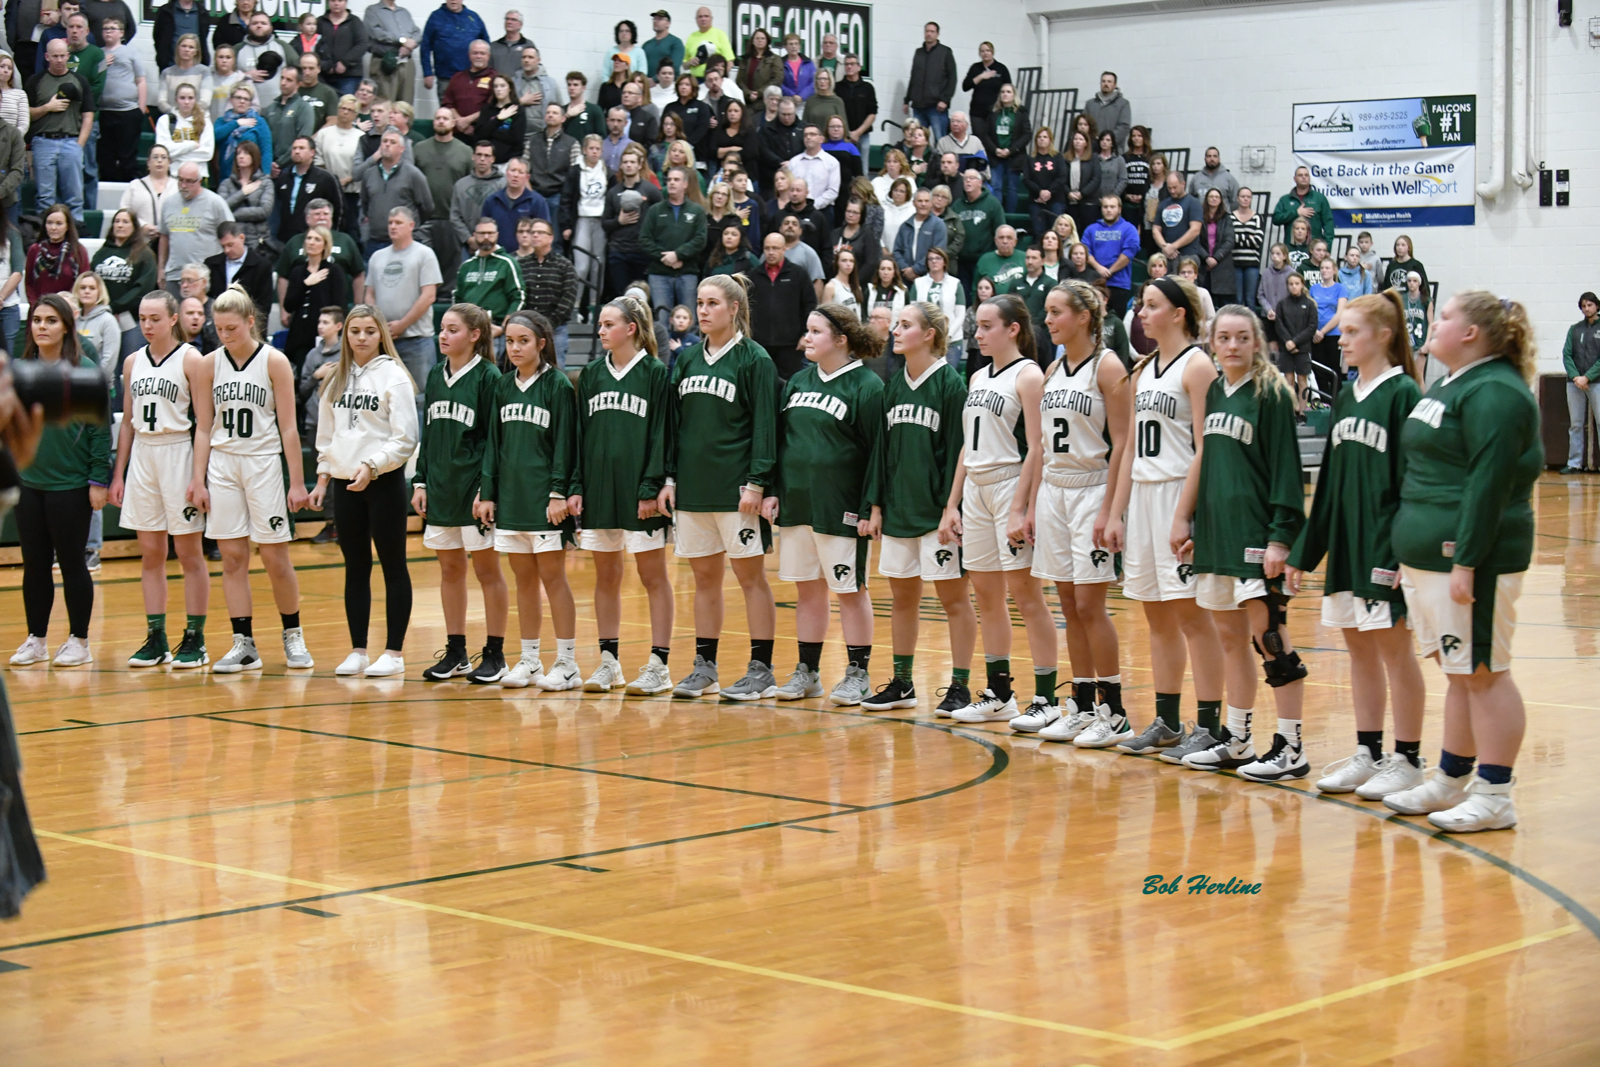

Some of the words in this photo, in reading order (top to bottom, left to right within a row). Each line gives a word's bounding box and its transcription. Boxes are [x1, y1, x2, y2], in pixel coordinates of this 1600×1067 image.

[1358, 111, 1408, 121] 989-695-2525
[1432, 103, 1472, 113] FALCONS
[1439, 112, 1461, 132] #1
[1442, 132, 1461, 142] FAN
[1311, 164, 1333, 178] Get
[1337, 164, 1368, 177] Back
[1372, 163, 1384, 176] in
[1389, 162, 1410, 176] the
[1414, 161, 1455, 175] Game
[1359, 183, 1389, 196] with
[1392, 179, 1457, 198] WellSport
[213, 381, 267, 407] REELAND
[782, 391, 848, 421] REELAND
[963, 389, 1005, 417] EELAND
[1041, 389, 1092, 417] REELAND
[1135, 390, 1176, 420] EELAND
[143, 402, 157, 431] 4
[222, 408, 253, 438] 40
[500, 403, 551, 428] REELAND
[1203, 411, 1253, 445] EELAND
[973, 416, 980, 451] 1
[1053, 418, 1069, 453] 2
[1138, 420, 1161, 458] 10
